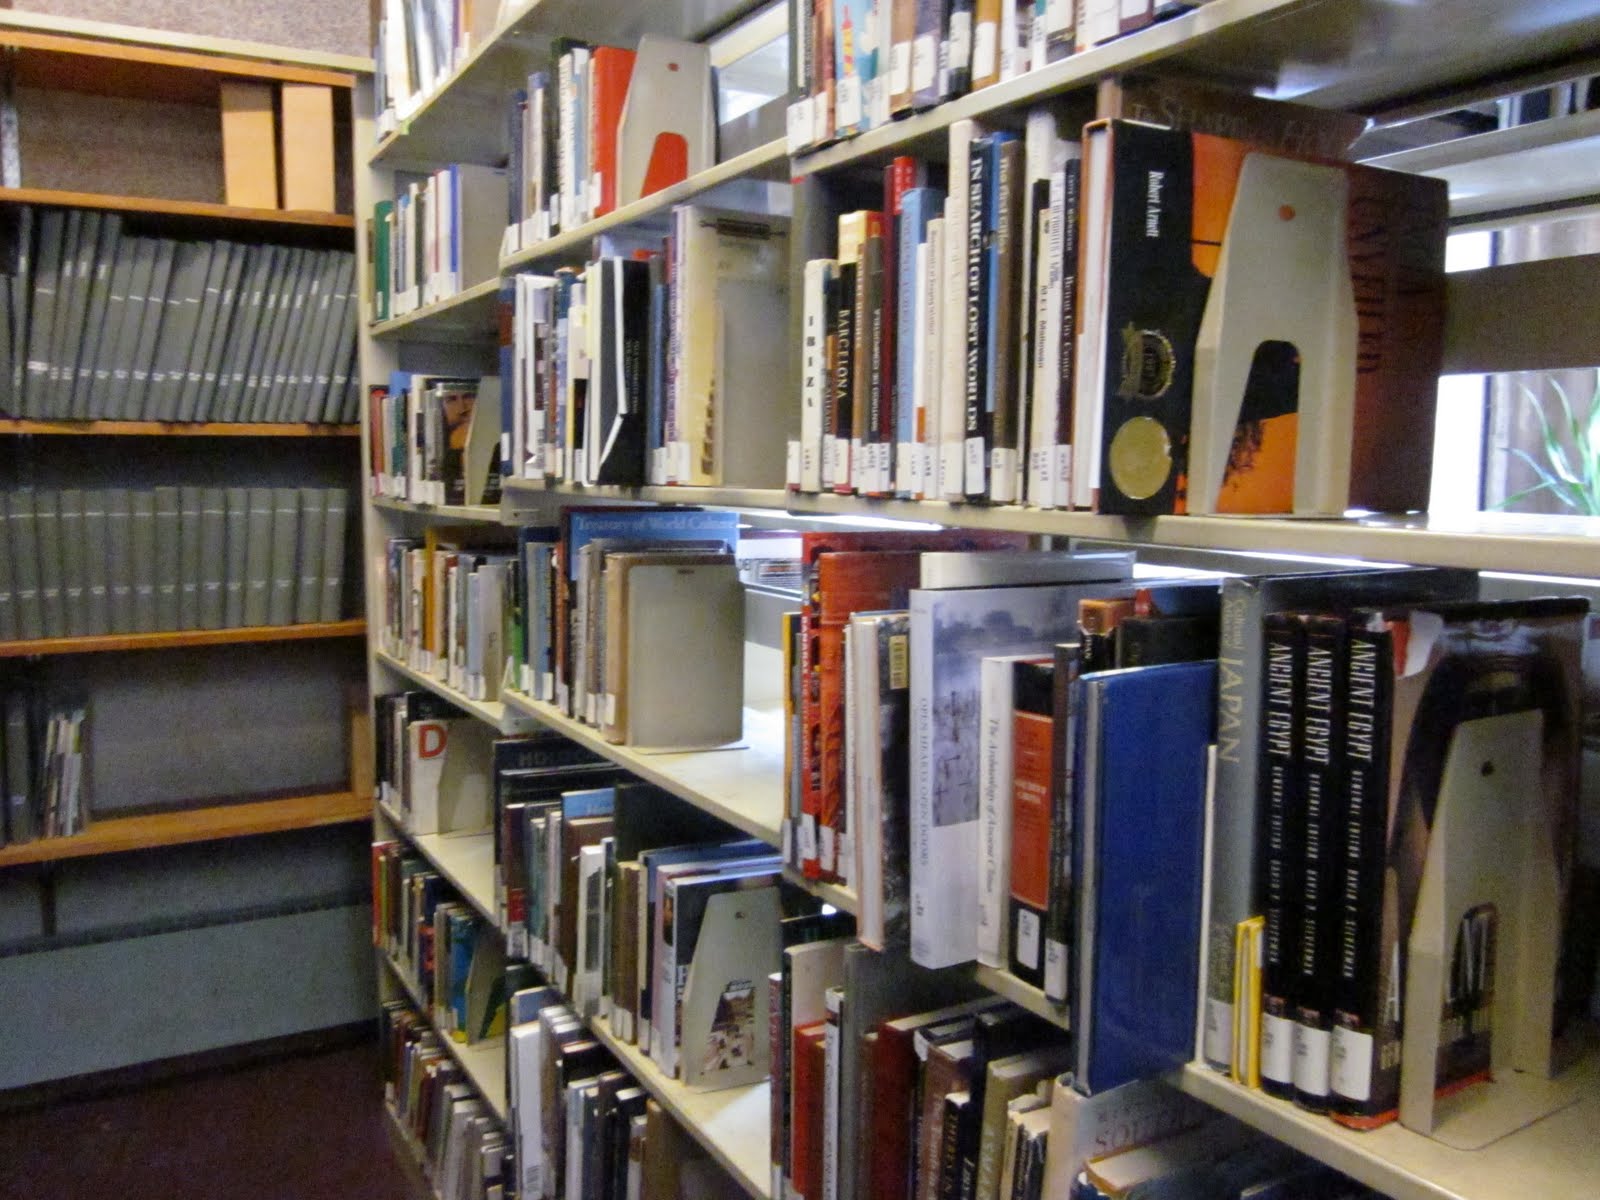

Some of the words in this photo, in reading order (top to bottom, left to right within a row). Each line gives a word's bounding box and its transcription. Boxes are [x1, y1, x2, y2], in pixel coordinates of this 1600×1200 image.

[970, 156, 983, 180] IN
[1147, 170, 1164, 204] Robert
[968, 182, 983, 264] SEARCH
[1146, 205, 1161, 238] Arnett
[968, 265, 981, 292] OF
[968, 294, 980, 346] LOST
[837, 309, 851, 400] BARCELONA
[966, 347, 979, 432] WORLDS
[1267, 641, 1294, 708] ANCIENT
[1305, 645, 1334, 713] ANCIENT
[1349, 638, 1377, 709] ANCIENT
[1219, 657, 1243, 764] JAPAN
[418, 724, 449, 759] D
[1266, 710, 1293, 759] EGYPT
[1304, 716, 1332, 767] EGYPT
[1346, 711, 1375, 764] EGYPT
[1271, 766, 1285, 809] GENERAL
[1308, 773, 1321, 817] GENERAL
[1349, 769, 1364, 816] GENERAL
[1270, 814, 1283, 849] EDITOR
[1307, 822, 1320, 860] EDITOR
[1348, 820, 1362, 859] EDITOR
[1270, 859, 1281, 889] DAVID
[1305, 868, 1319, 900] DAVID
[1346, 868, 1360, 900] DAVID
